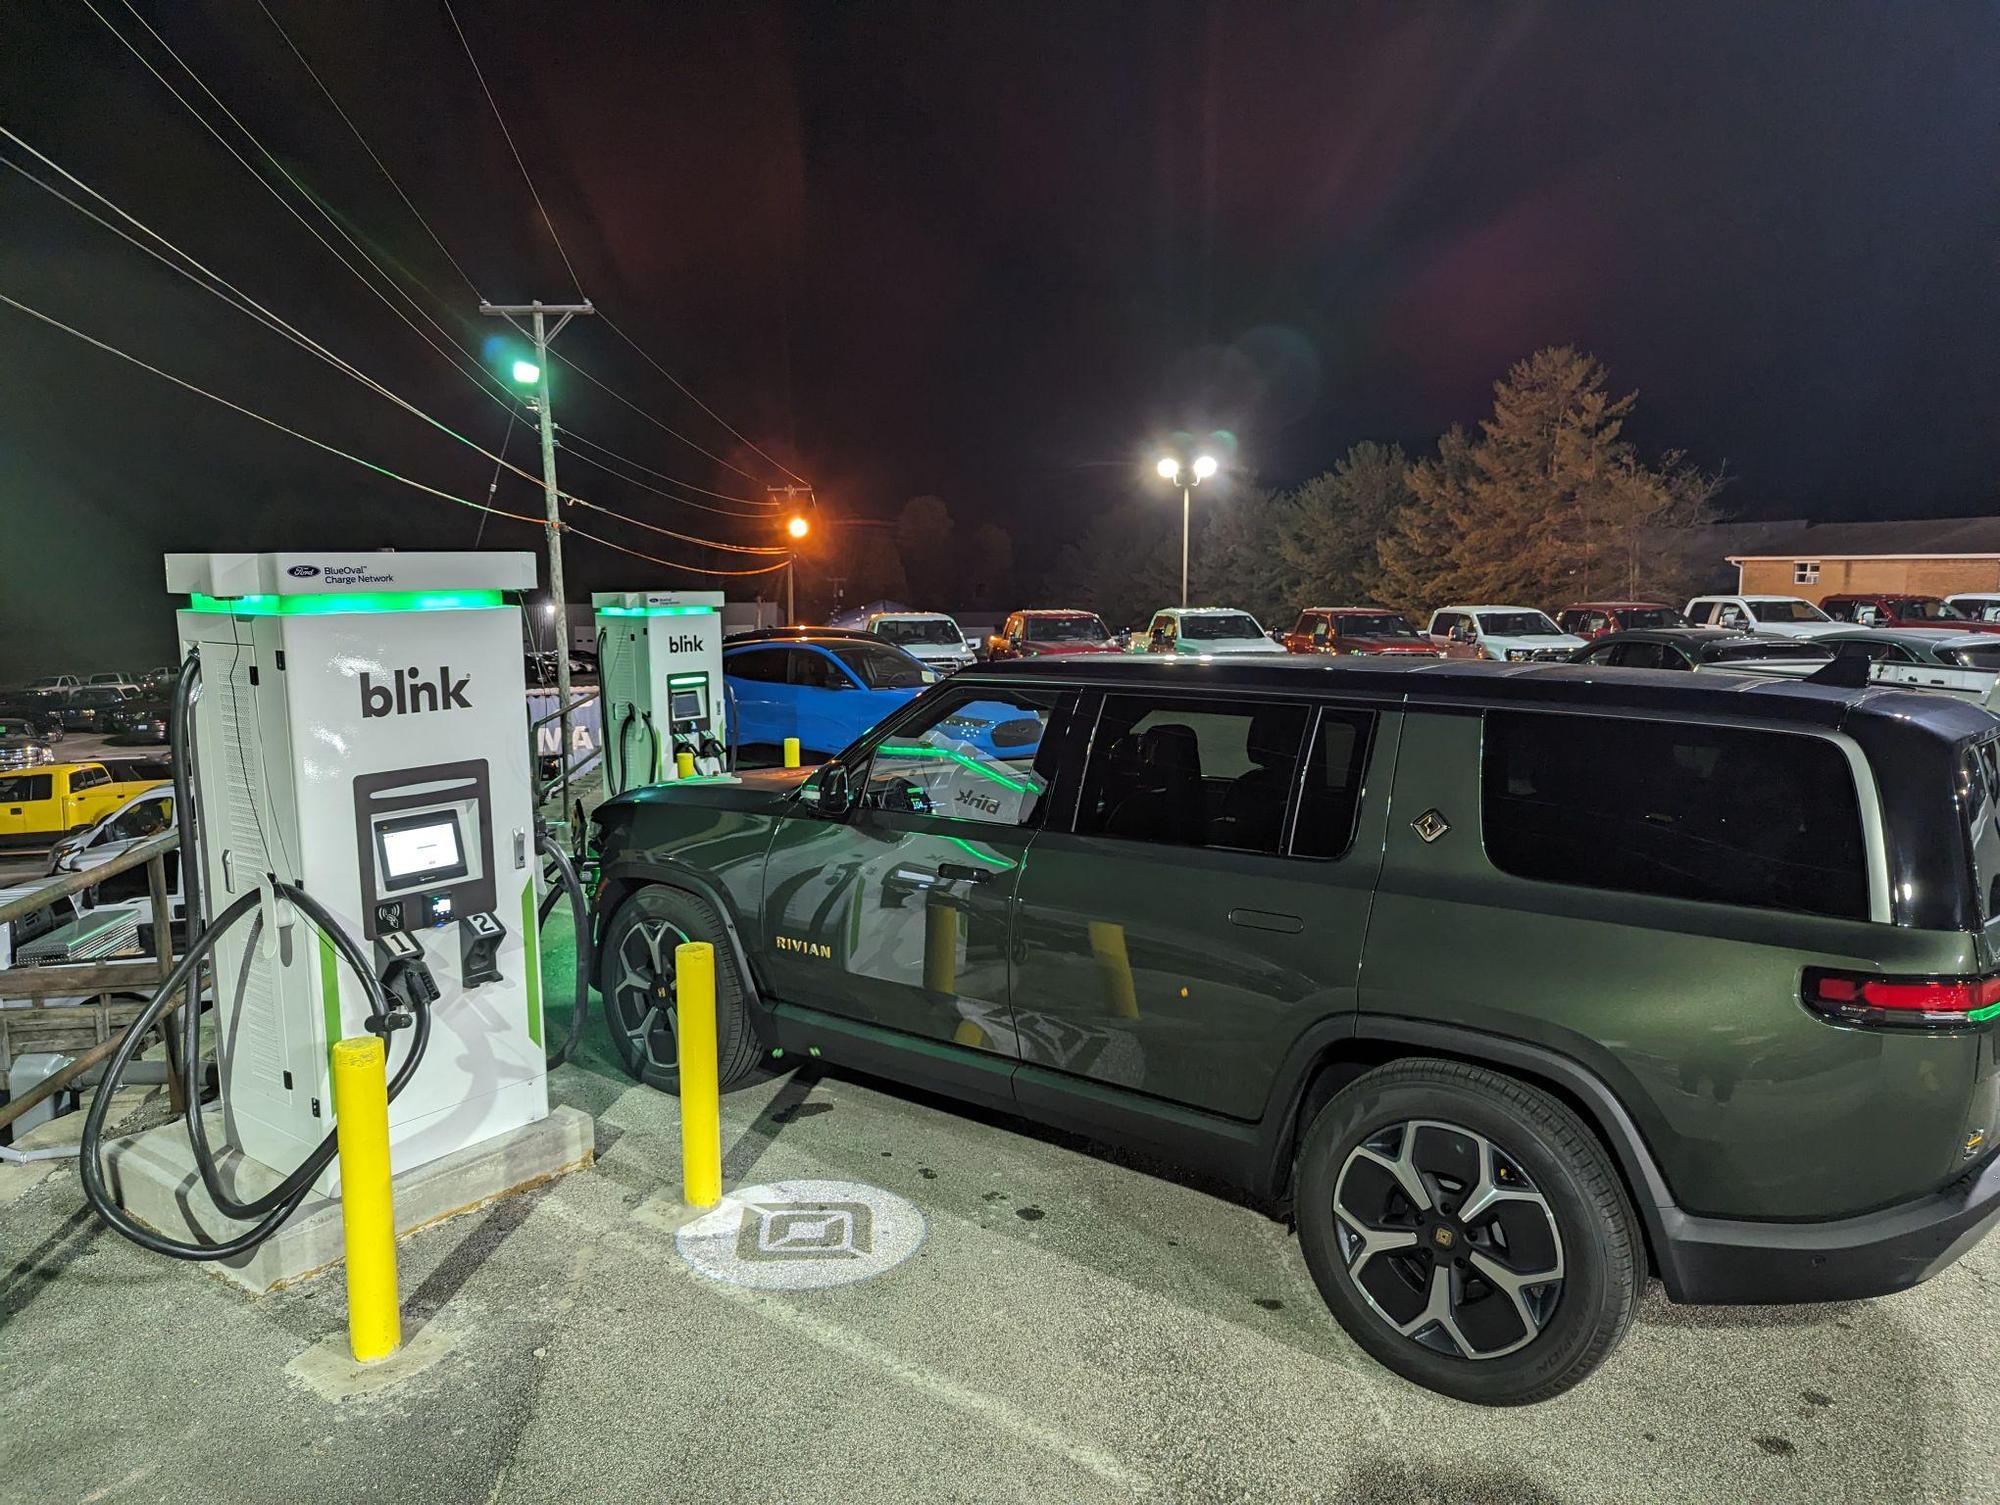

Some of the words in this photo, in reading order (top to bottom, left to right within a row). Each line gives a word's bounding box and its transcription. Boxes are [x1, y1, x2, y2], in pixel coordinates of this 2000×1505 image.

[325, 575, 356, 584] Charge
[358, 574, 393, 583] Network
[669, 634, 705, 653] blink
[473, 914, 496, 933] 2
[390, 934, 411, 952] 1
[775, 935, 832, 959] RIVIAN
